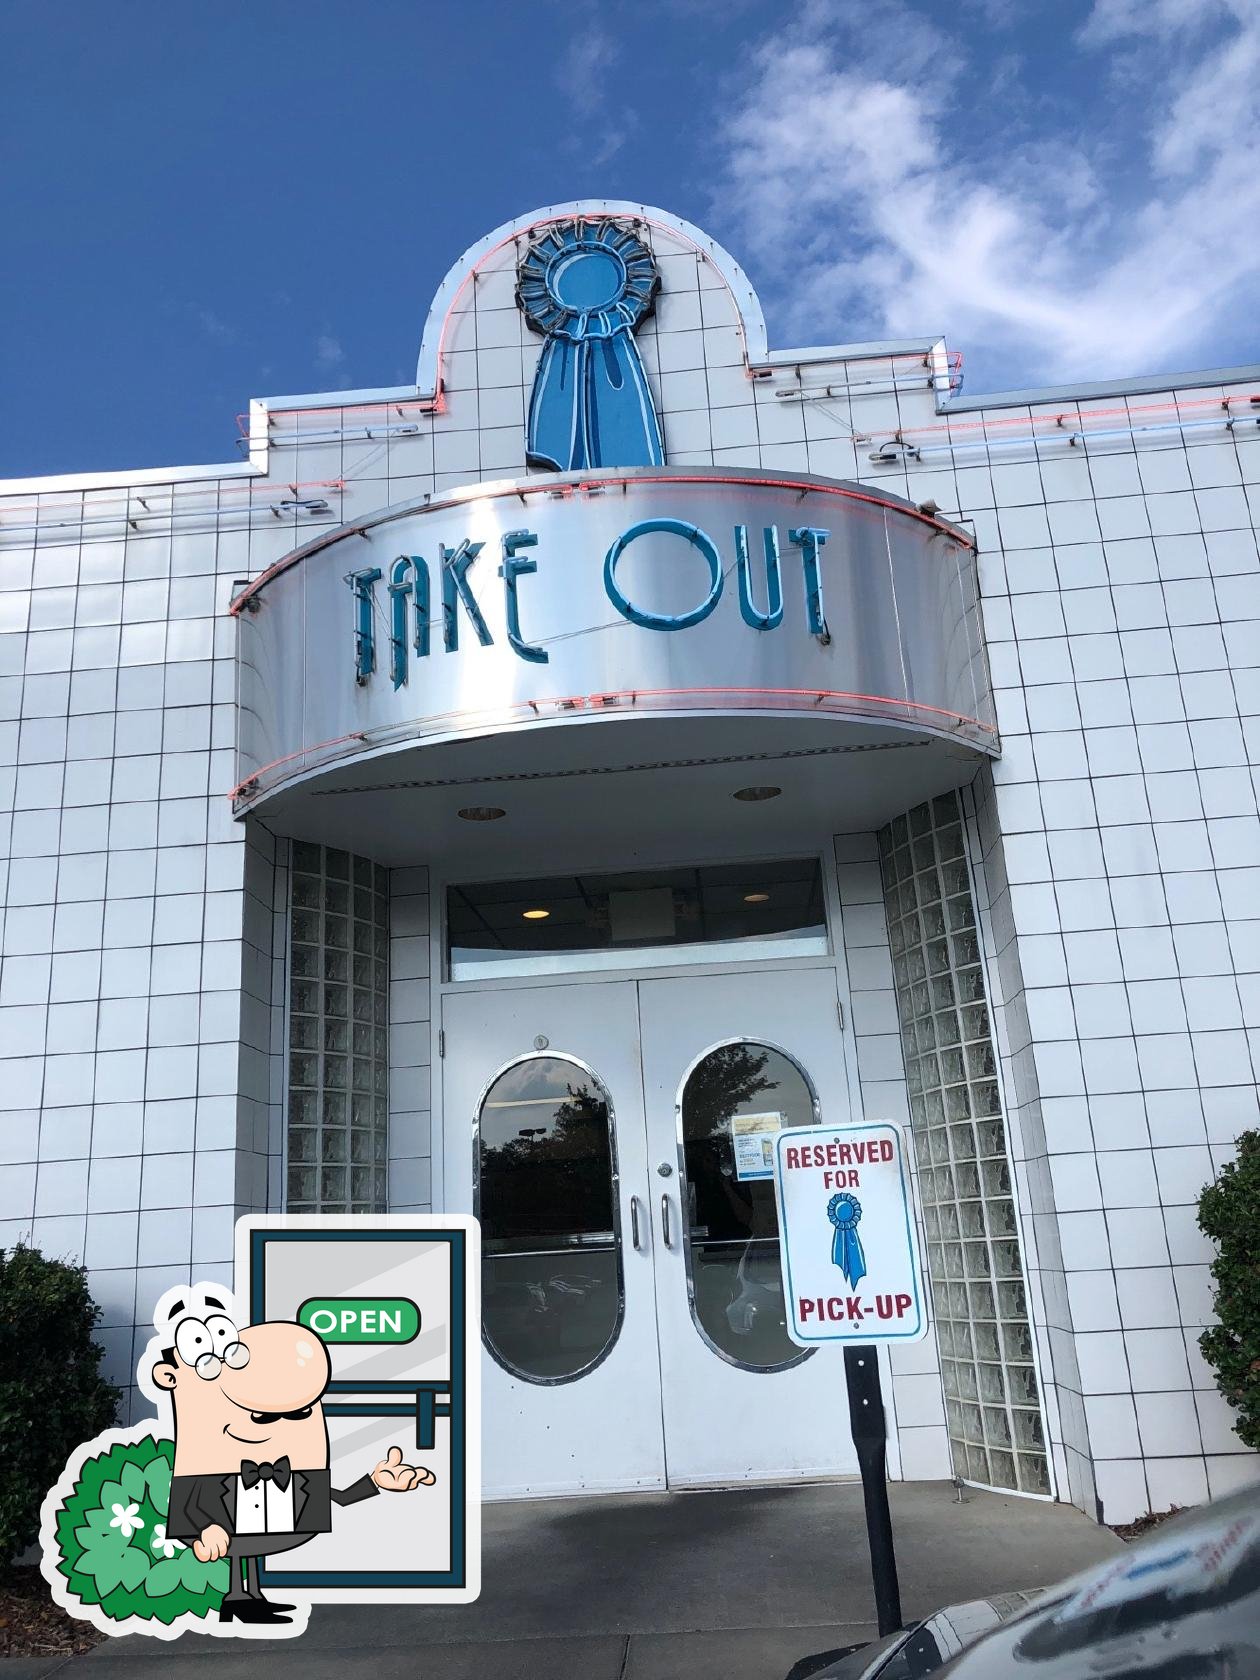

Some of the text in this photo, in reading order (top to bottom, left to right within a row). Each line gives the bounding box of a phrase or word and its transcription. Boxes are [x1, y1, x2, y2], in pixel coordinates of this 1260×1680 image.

[343, 517, 832, 692] TAKE OUT
[786, 1140, 894, 1169] RESERVED
[823, 1170, 860, 1190] FOR
[799, 1294, 912, 1322] PICK-UP
